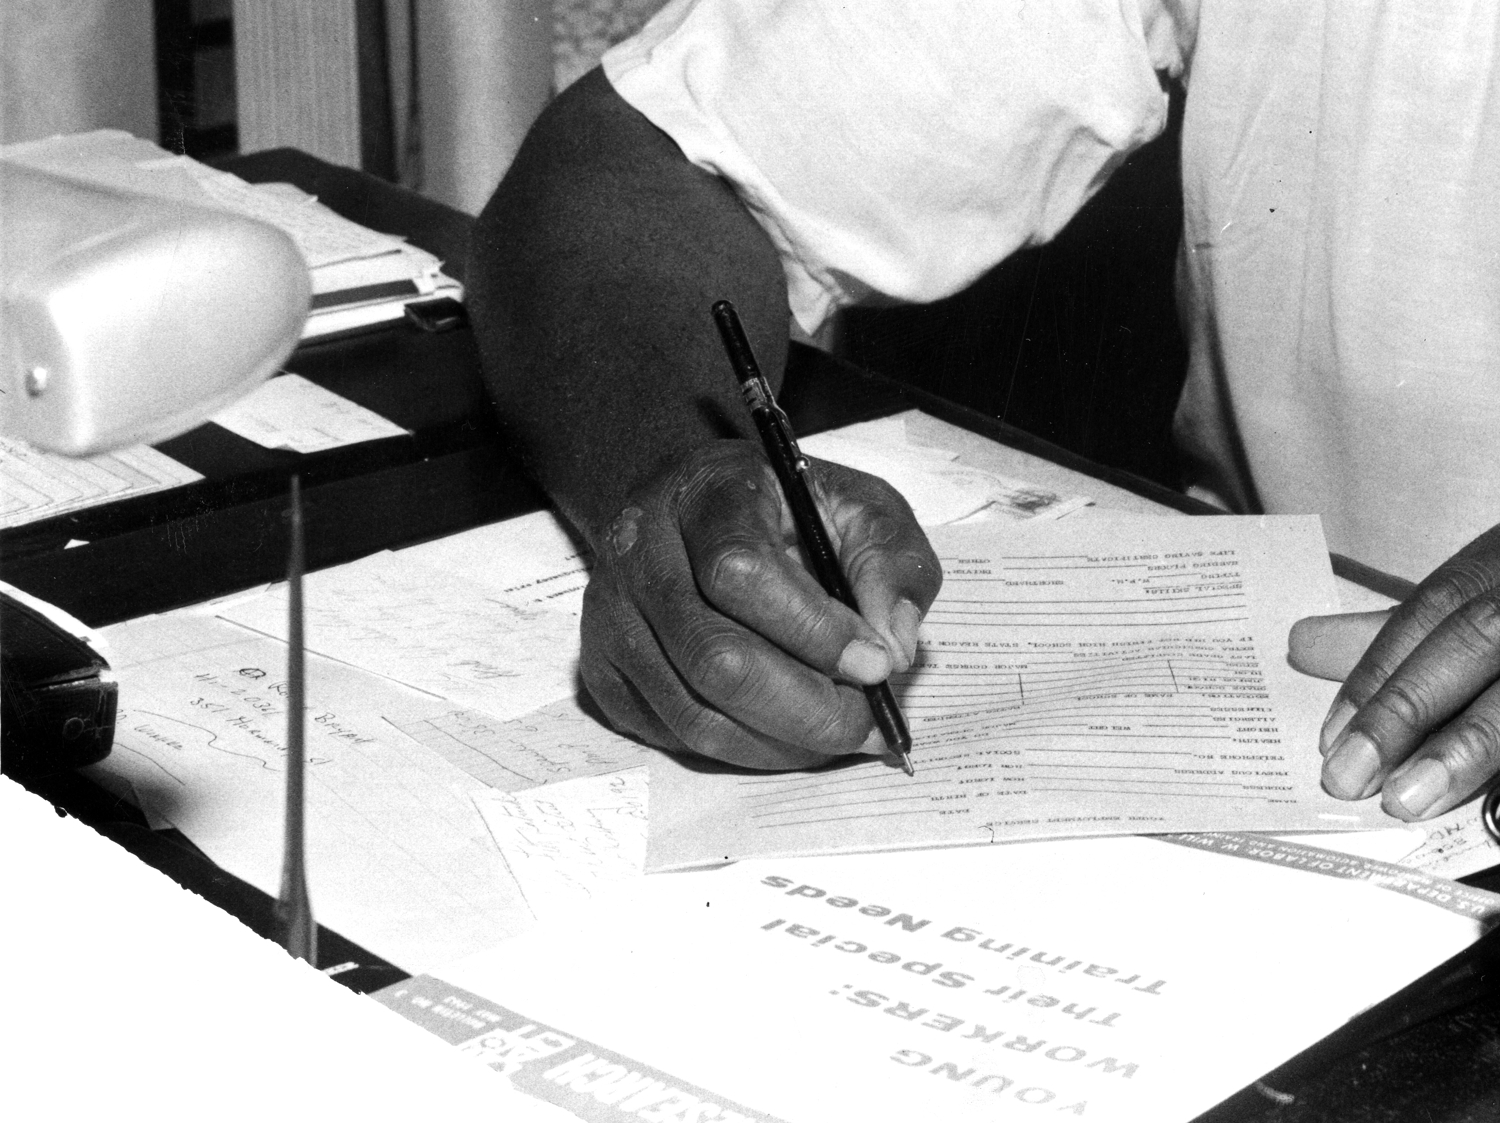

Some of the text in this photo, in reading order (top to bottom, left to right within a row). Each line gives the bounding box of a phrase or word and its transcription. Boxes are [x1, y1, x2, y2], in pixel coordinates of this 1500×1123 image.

[1163, 551, 1204, 560] SAVING
[1208, 549, 1236, 557] LIFE
[1086, 553, 1159, 563] CERTIFICATE
[1146, 562, 1187, 572] FLOORS
[1200, 572, 1242, 580] TYPING
[1194, 583, 1243, 593] SPECIAL
[1088, 724, 1132, 732] WEIGHT
[975, 749, 1021, 757] SOCIAL
[1219, 754, 1285, 762] TELEPHONE
[1173, 768, 1290, 777] PREVIOUS ADDRESS
[1241, 784, 1294, 792] ADDRESS
[930, 793, 967, 802] BIRTH
[938, 808, 970, 816] DATE
[1046, 815, 1121, 824] EMPLOYMENT
[1307, 857, 1334, 873] OF
[759, 874, 1168, 997] Training Needs
[759, 917, 1123, 1029] Their Special
[827, 983, 1141, 1080] WORKERS:
[888, 1047, 1089, 1117] YOUNG
